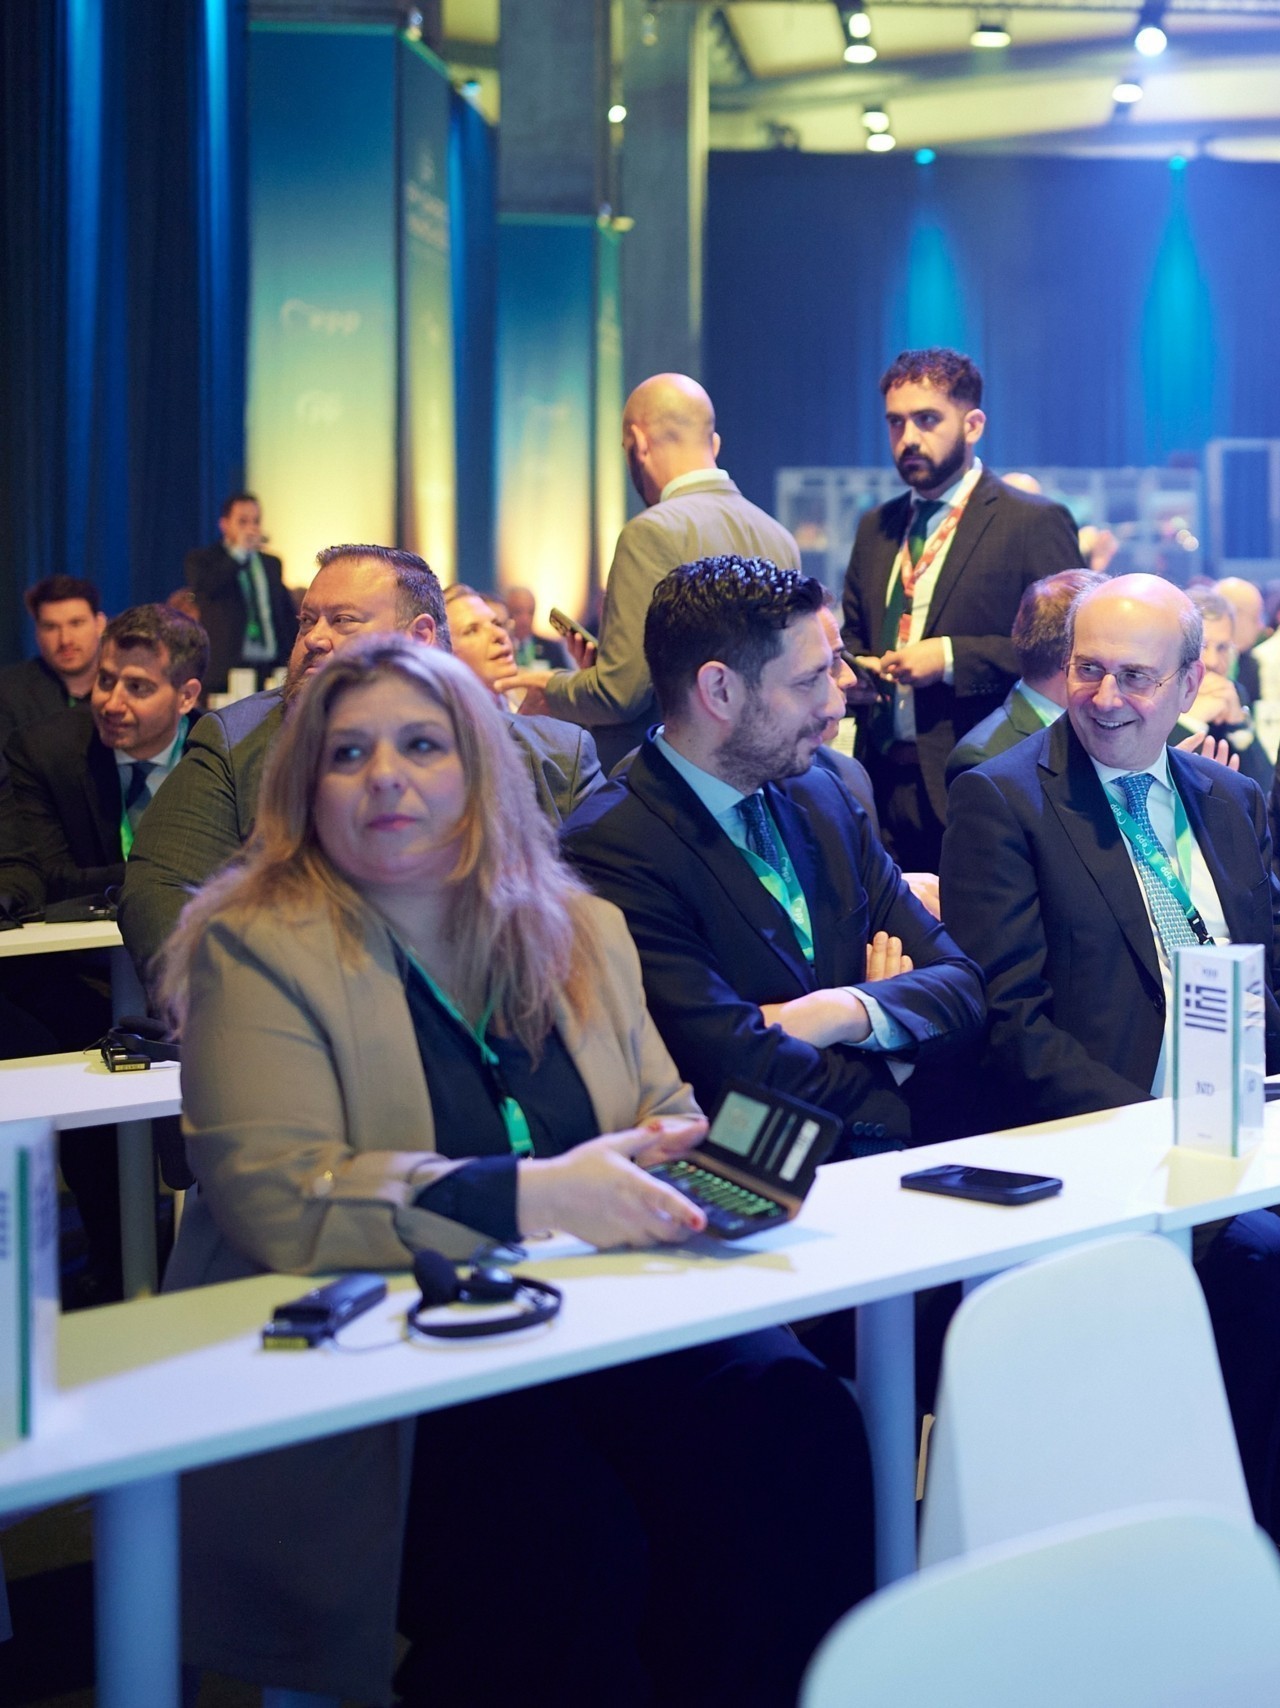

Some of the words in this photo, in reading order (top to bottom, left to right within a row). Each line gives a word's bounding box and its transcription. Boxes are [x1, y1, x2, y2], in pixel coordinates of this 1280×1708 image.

[1110, 803, 1122, 817] epp
[1135, 833, 1148, 848] epp
[781, 866, 792, 883] epp
[1160, 866, 1173, 881] epp
[1195, 1080, 1216, 1096] ND
